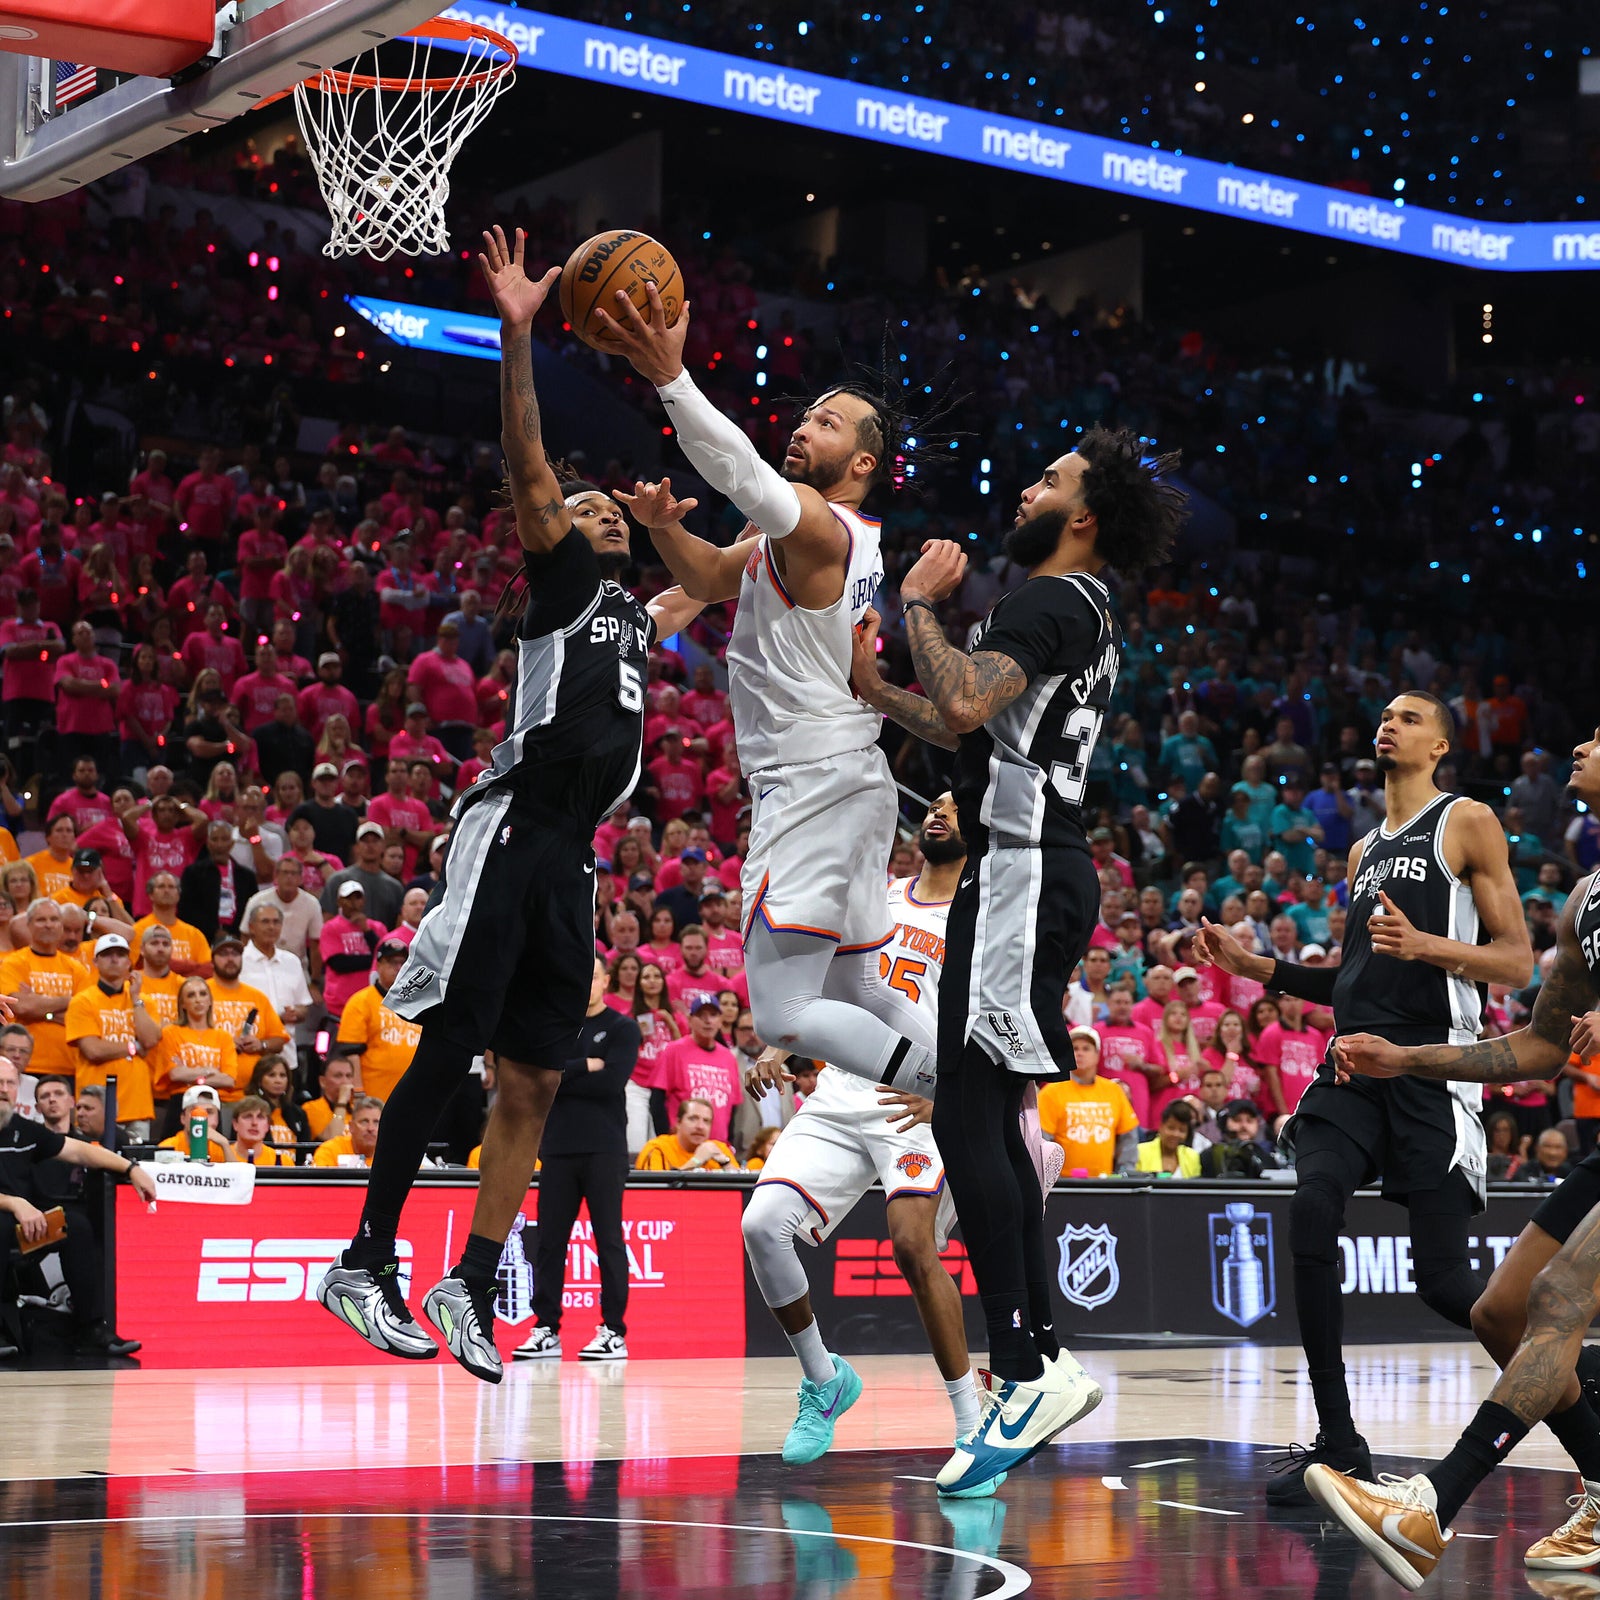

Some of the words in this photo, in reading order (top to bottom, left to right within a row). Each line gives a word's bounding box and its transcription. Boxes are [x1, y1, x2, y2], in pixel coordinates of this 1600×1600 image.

[585, 38, 686, 86] meter
[724, 69, 820, 116] meter
[857, 98, 949, 143] meter
[982, 125, 1071, 170] meter
[1103, 152, 1188, 194] meter
[1217, 177, 1298, 218] meter
[1328, 201, 1404, 240] meter
[1433, 224, 1514, 261] meter
[1553, 233, 1600, 261] me
[618, 659, 643, 714] 5
[1049, 704, 1104, 806] 3
[156, 1173, 230, 1188] GATORADE
[897, 1153, 932, 1168] KNICKS
[637, 1220, 673, 1240] CUP
[1072, 1246, 1107, 1291] NHL
[1337, 1236, 1418, 1294] OME
[561, 1291, 594, 1308] 026
